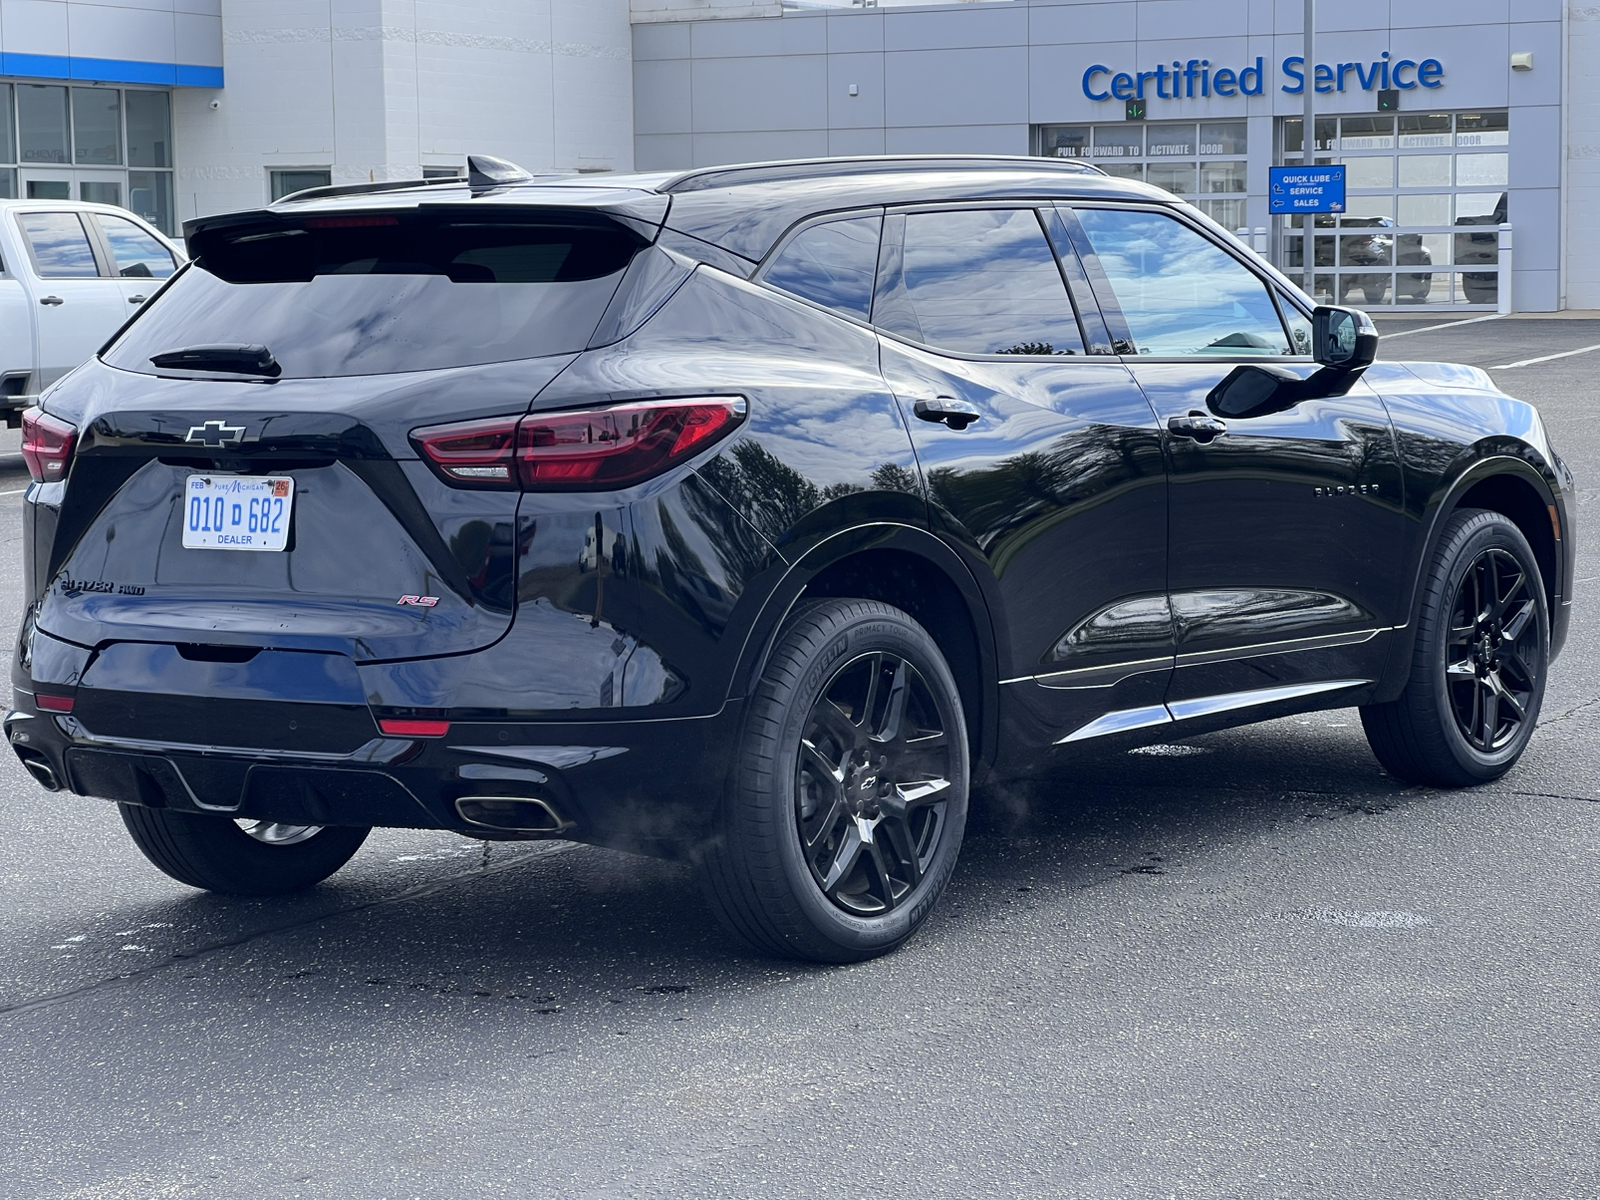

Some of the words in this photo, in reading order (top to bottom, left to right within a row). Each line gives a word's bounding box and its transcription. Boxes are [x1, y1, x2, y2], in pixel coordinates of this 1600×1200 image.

[1082, 56, 1265, 101] Certified
[1281, 51, 1444, 95] Service
[1379, 138, 1390, 148] TO
[1403, 135, 1445, 147] ACTIVATE
[1457, 135, 1482, 146] DOOR
[1057, 147, 1077, 157] PULL
[1080, 145, 1124, 157] FORWARD
[1128, 145, 1140, 156] TO
[1150, 144, 1190, 155] ACTIVATE
[1200, 144, 1224, 154] DOOR
[1283, 175, 1308, 184] QUICK
[1310, 174, 1331, 183] LUBE
[1290, 187, 1323, 195] SERVICE
[1294, 199, 1319, 207] SALES
[191, 481, 204, 489] FEB
[276, 481, 286, 490] 26
[190, 496, 224, 532] 010
[248, 497, 283, 533] 682
[218, 535, 252, 545] DEALER
[396, 594, 440, 607] RS
[854, 624, 886, 638] PRIMACY
[889, 625, 908, 638] TOUR
[799, 635, 848, 711] MICHELIN
